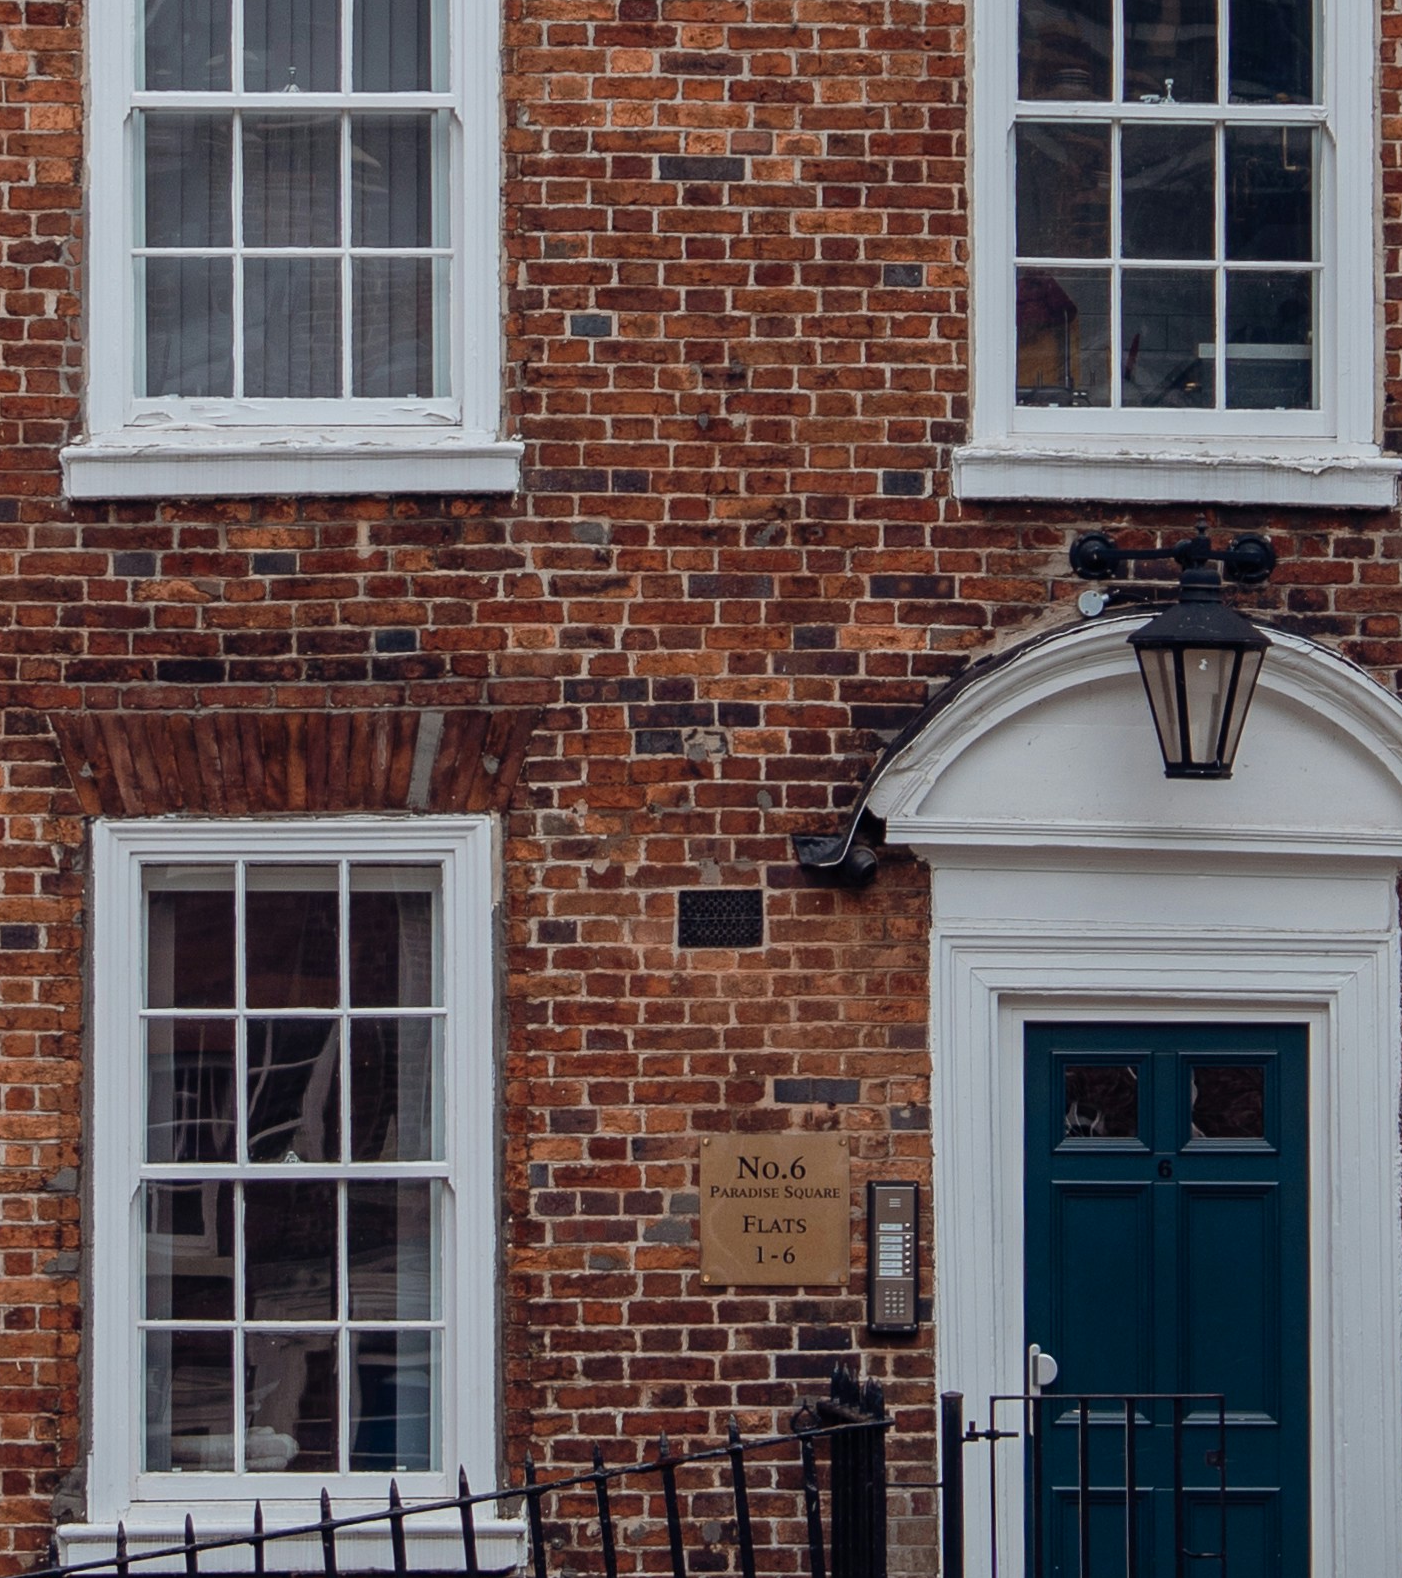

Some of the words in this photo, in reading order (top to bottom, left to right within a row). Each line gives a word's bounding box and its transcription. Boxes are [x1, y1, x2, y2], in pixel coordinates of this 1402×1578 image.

[1158, 1158, 1173, 1179] 6
[710, 1185, 780, 1199] PARADISE
[784, 1185, 841, 1200] SQUARE
[742, 1214, 807, 1234] FLATS
